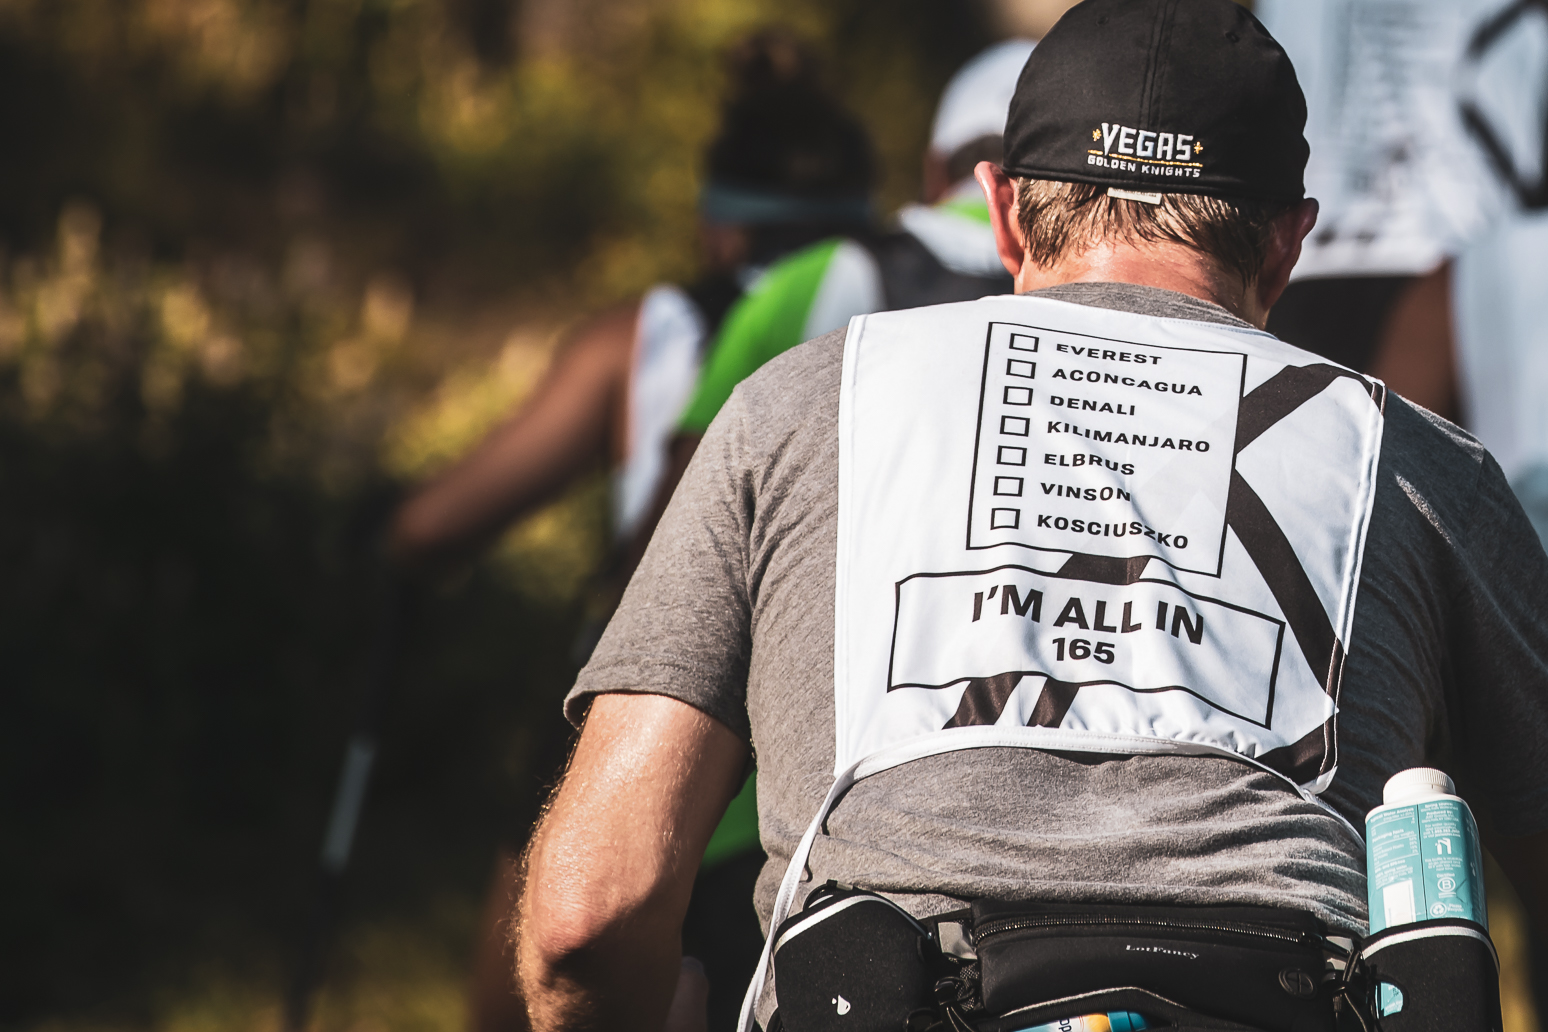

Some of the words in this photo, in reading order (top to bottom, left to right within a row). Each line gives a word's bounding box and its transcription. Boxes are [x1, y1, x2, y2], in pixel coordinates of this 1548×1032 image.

[1101, 123, 1194, 161] VEGAS
[1087, 155, 1136, 172] GOLDEN
[1141, 163, 1201, 178] KNIGHTS
[1056, 343, 1162, 365] EVEREST
[1051, 368, 1203, 397] ACONCAGUA
[1050, 395, 1136, 416] DENALI
[1047, 421, 1210, 453] KILIMANJARO
[1043, 453, 1135, 476] ELBRUS
[1040, 482, 1131, 502] VINSON
[1036, 513, 1189, 549] KOSCIUSZKO
[971, 584, 1044, 623] I'M
[1052, 596, 1142, 634] ALL
[1155, 600, 1204, 646] IN
[1052, 637, 1116, 665] 165
[1126, 945, 1199, 960] LotFancy
